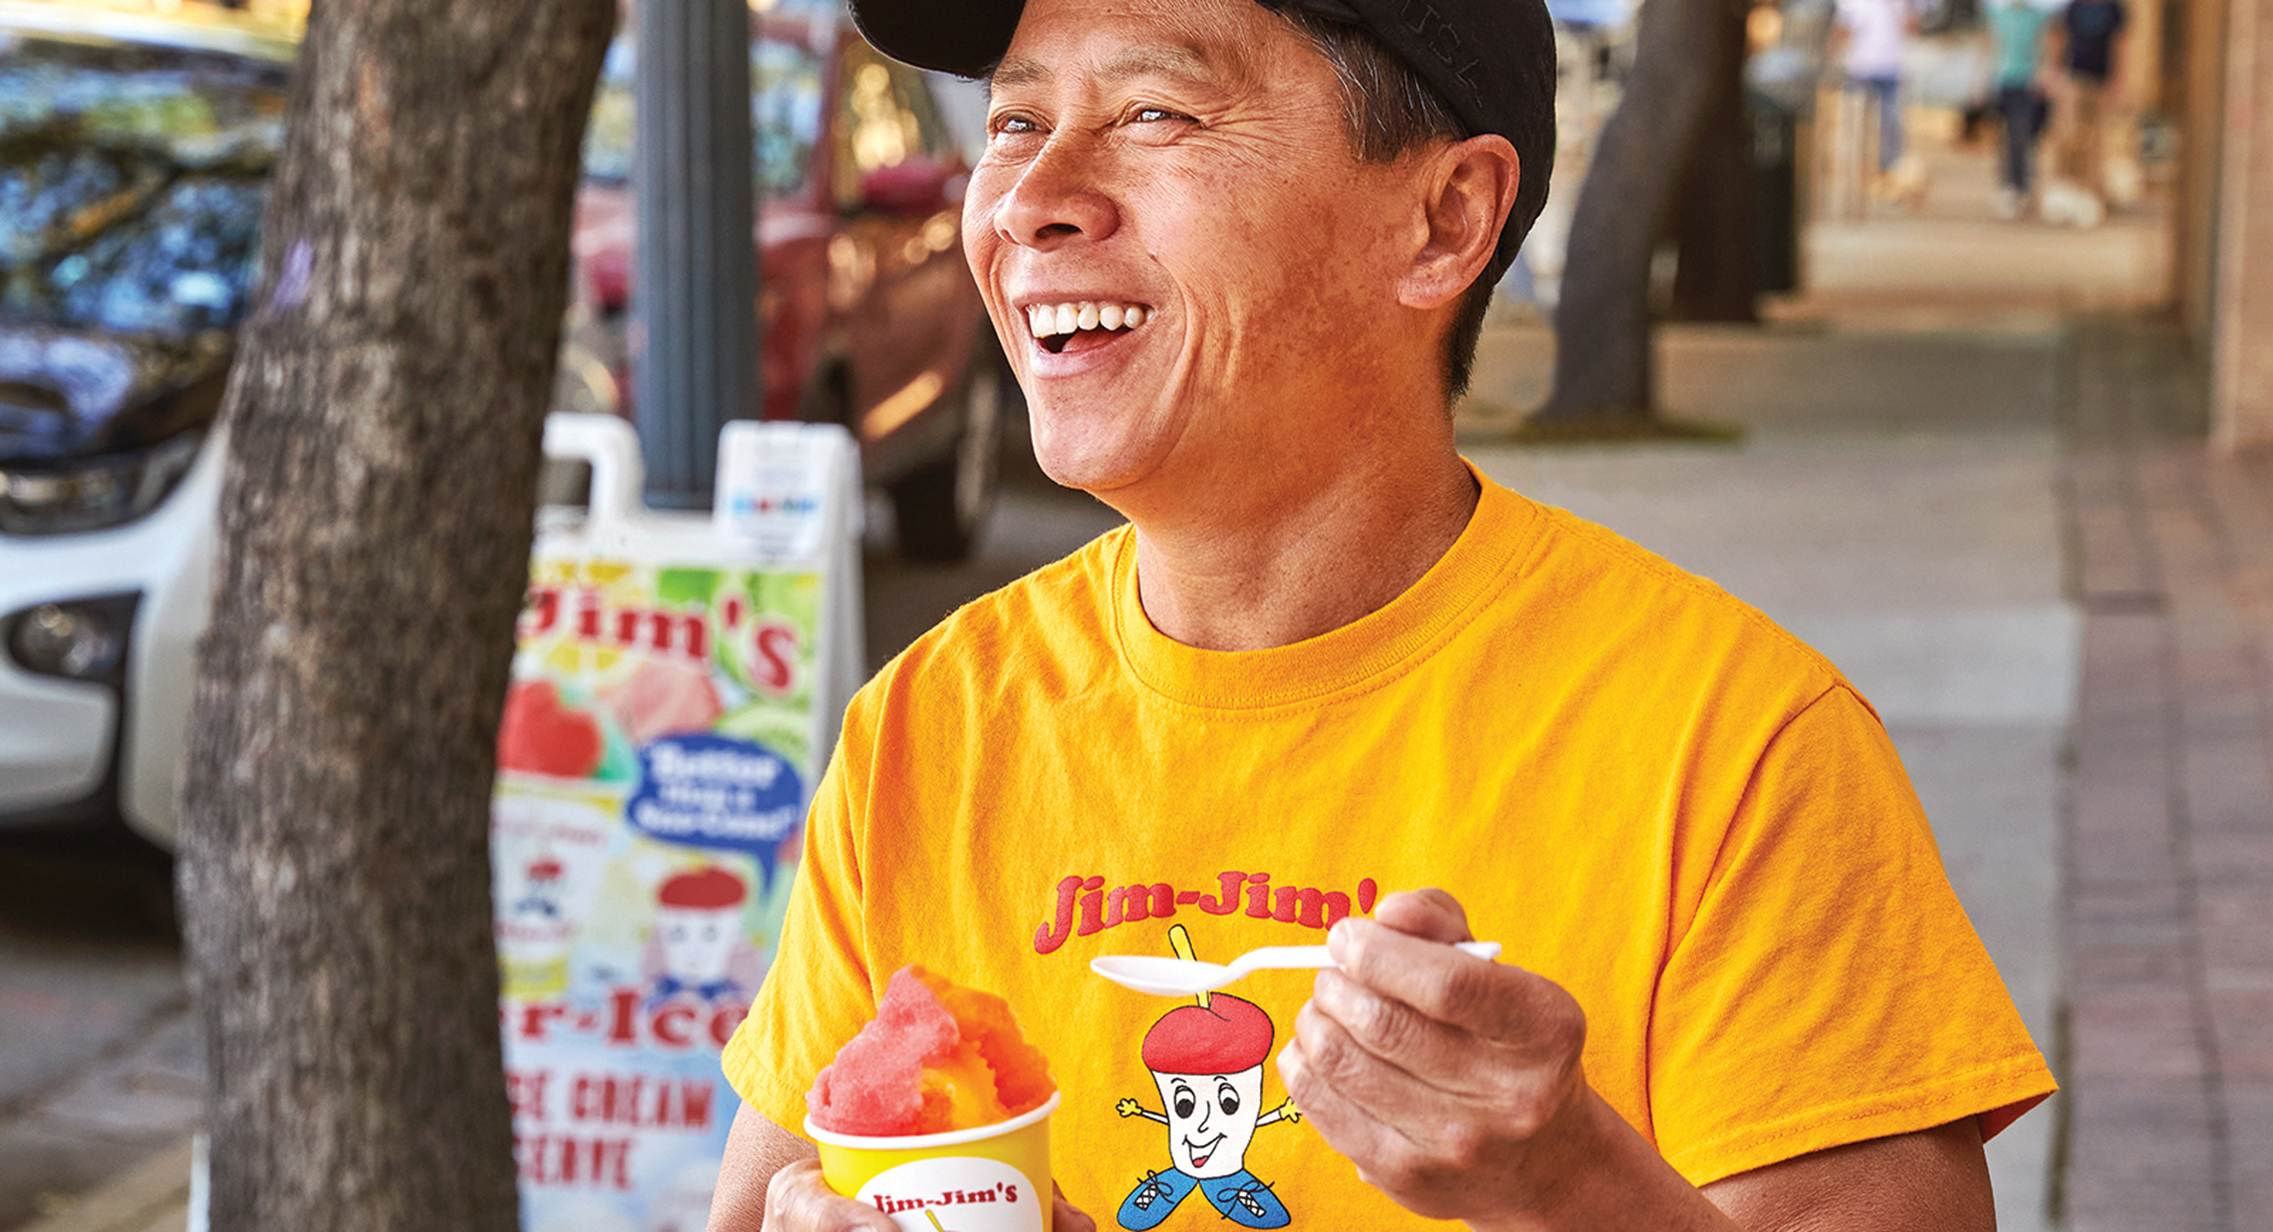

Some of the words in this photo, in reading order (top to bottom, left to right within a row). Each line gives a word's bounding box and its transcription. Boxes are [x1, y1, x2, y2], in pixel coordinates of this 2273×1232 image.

[1034, 870, 1378, 955] Jim-Jim'
[500, 990, 750, 1050] r-Ice
[570, 1072, 716, 1132] CREAM
[873, 1181, 1018, 1215] Jim-Jim's
